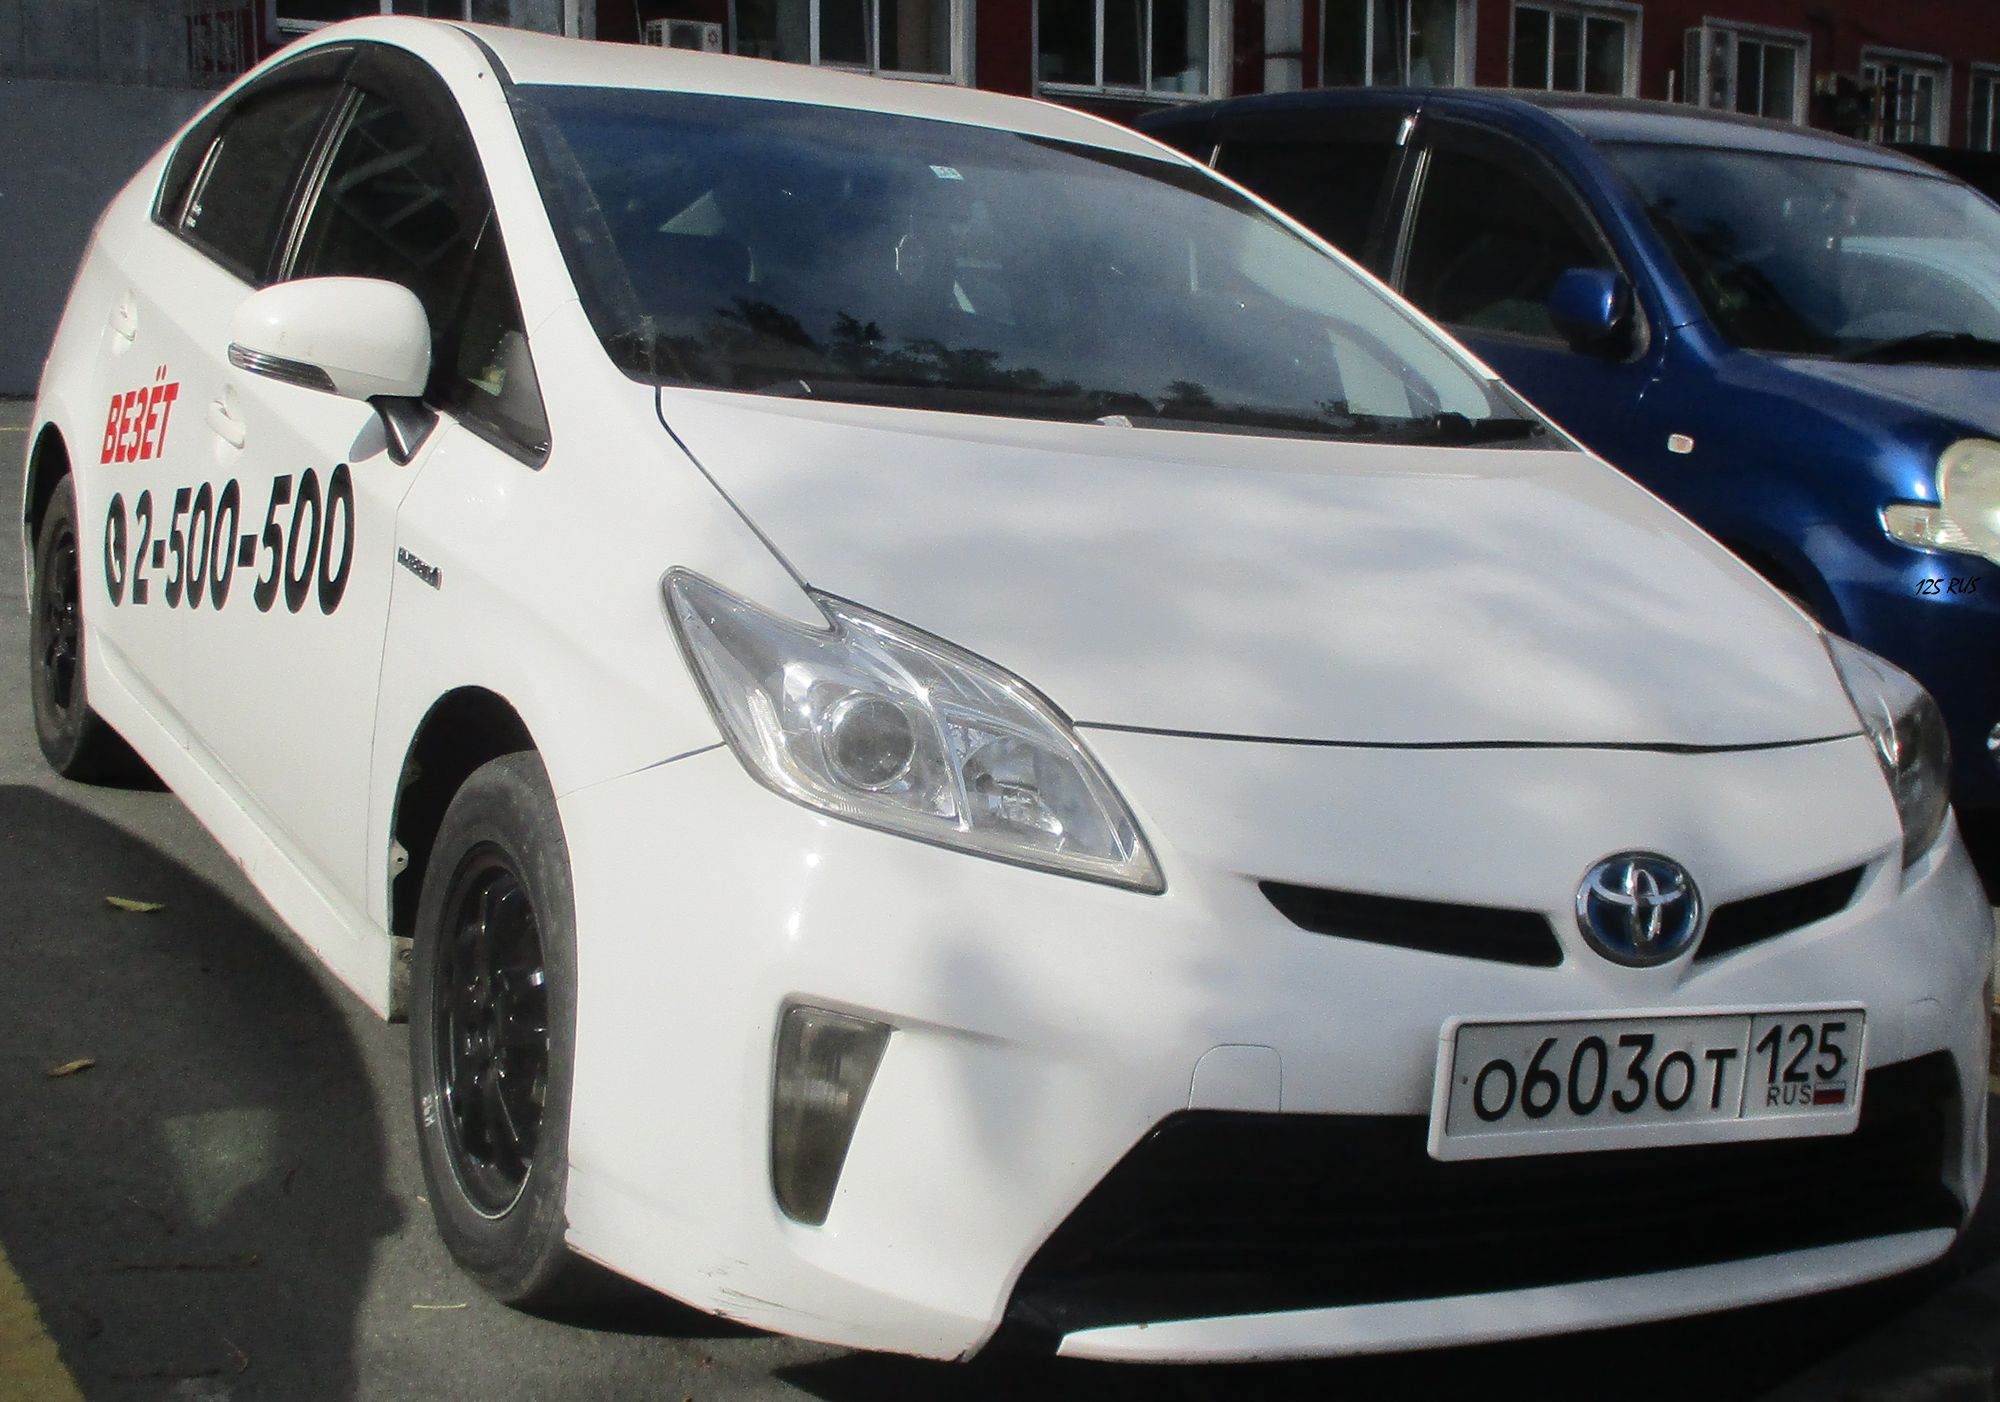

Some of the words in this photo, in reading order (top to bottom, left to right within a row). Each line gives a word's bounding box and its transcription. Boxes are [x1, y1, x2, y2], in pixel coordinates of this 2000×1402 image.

[100, 364, 179, 464] ВЕЗЁТ
[133, 463, 355, 615] 2-500-500
[1756, 1022, 1847, 1084] 125
[1766, 1084, 1812, 1107] RUS
